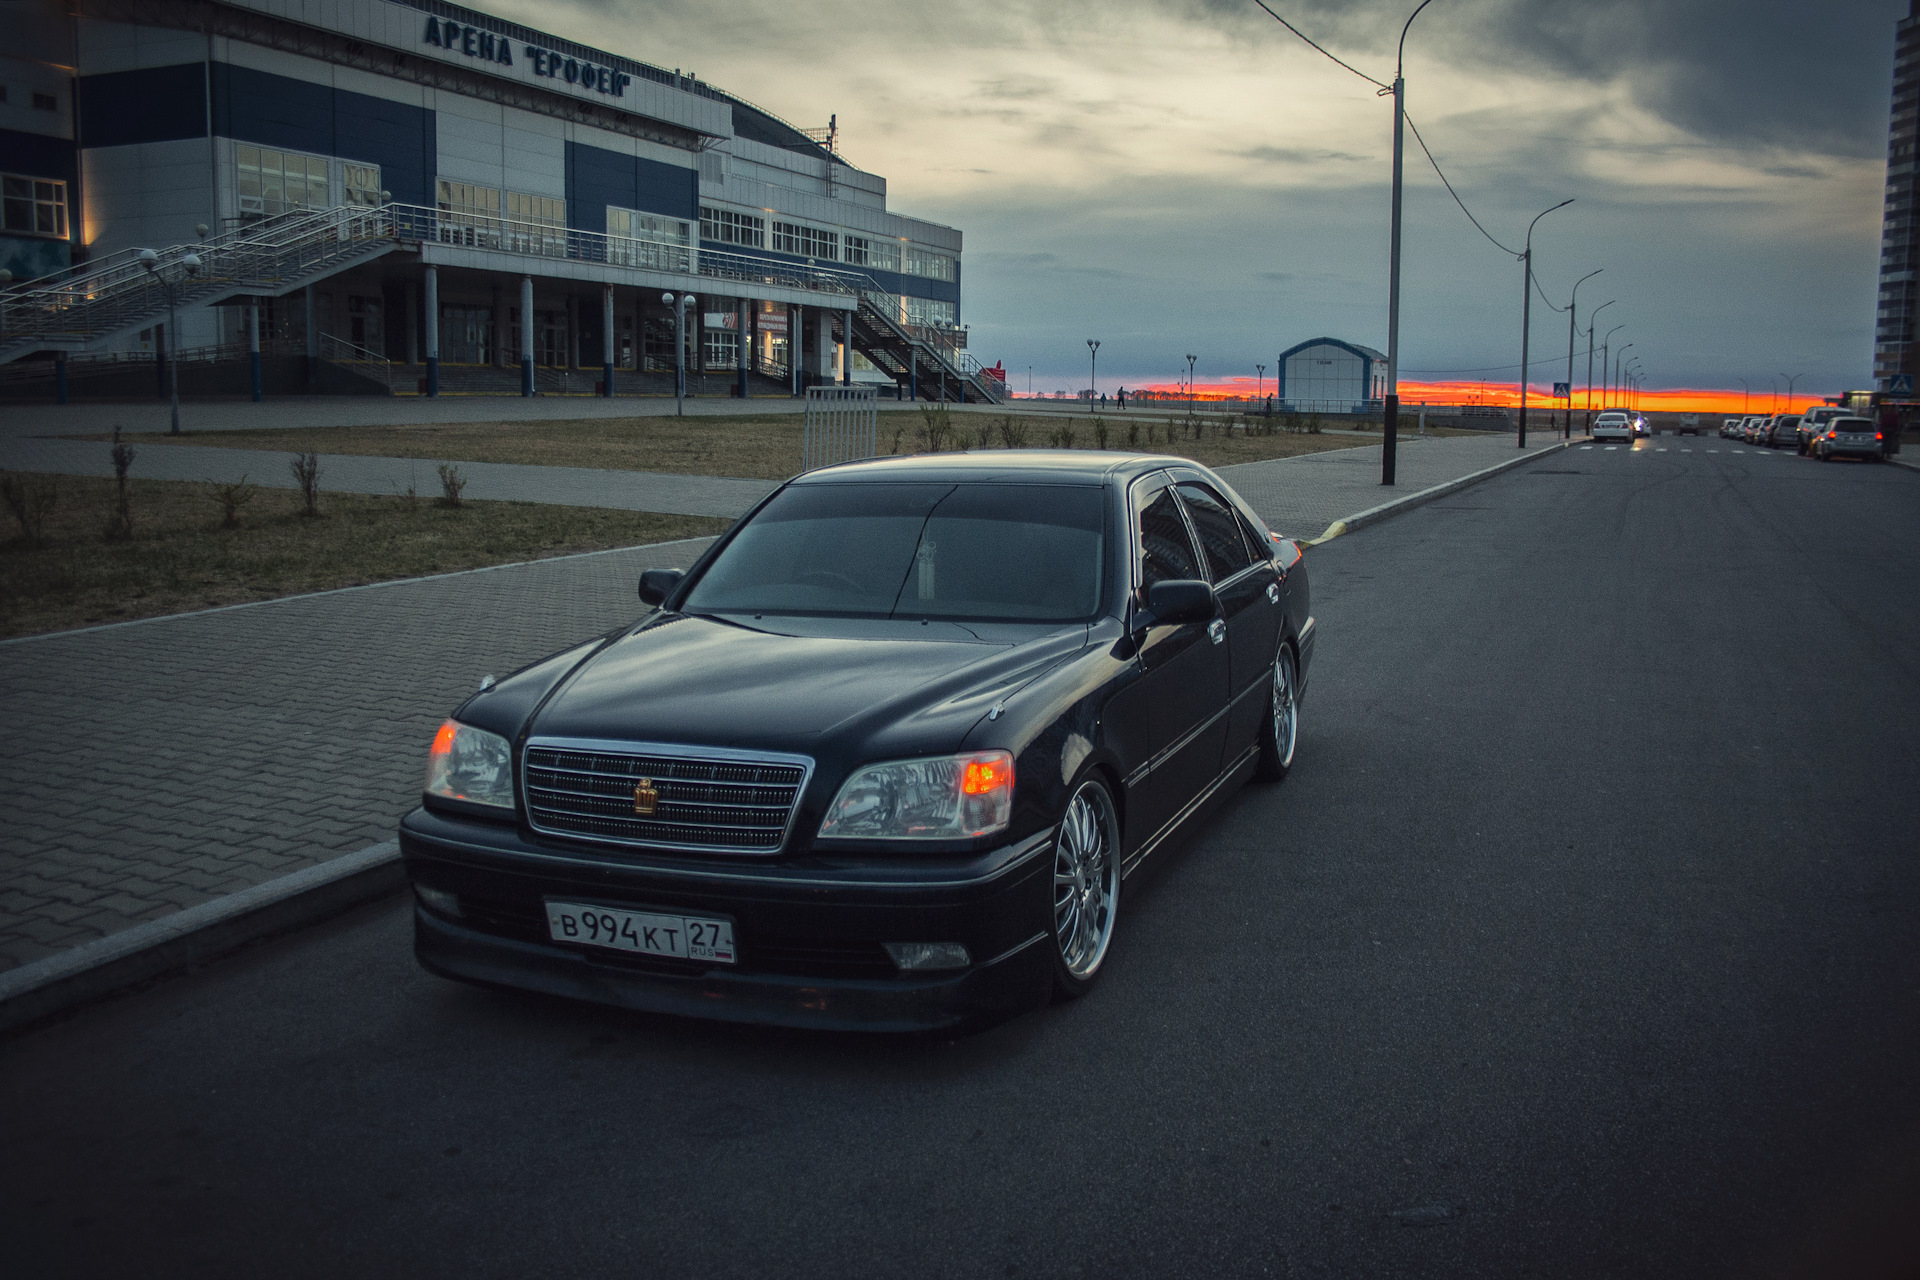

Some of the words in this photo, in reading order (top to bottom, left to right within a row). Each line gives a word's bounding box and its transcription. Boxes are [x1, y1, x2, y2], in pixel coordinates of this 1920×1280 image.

[426, 16, 513, 66] АРЕНА
[690, 922, 720, 947] 27
[691, 946, 714, 957] RUS
